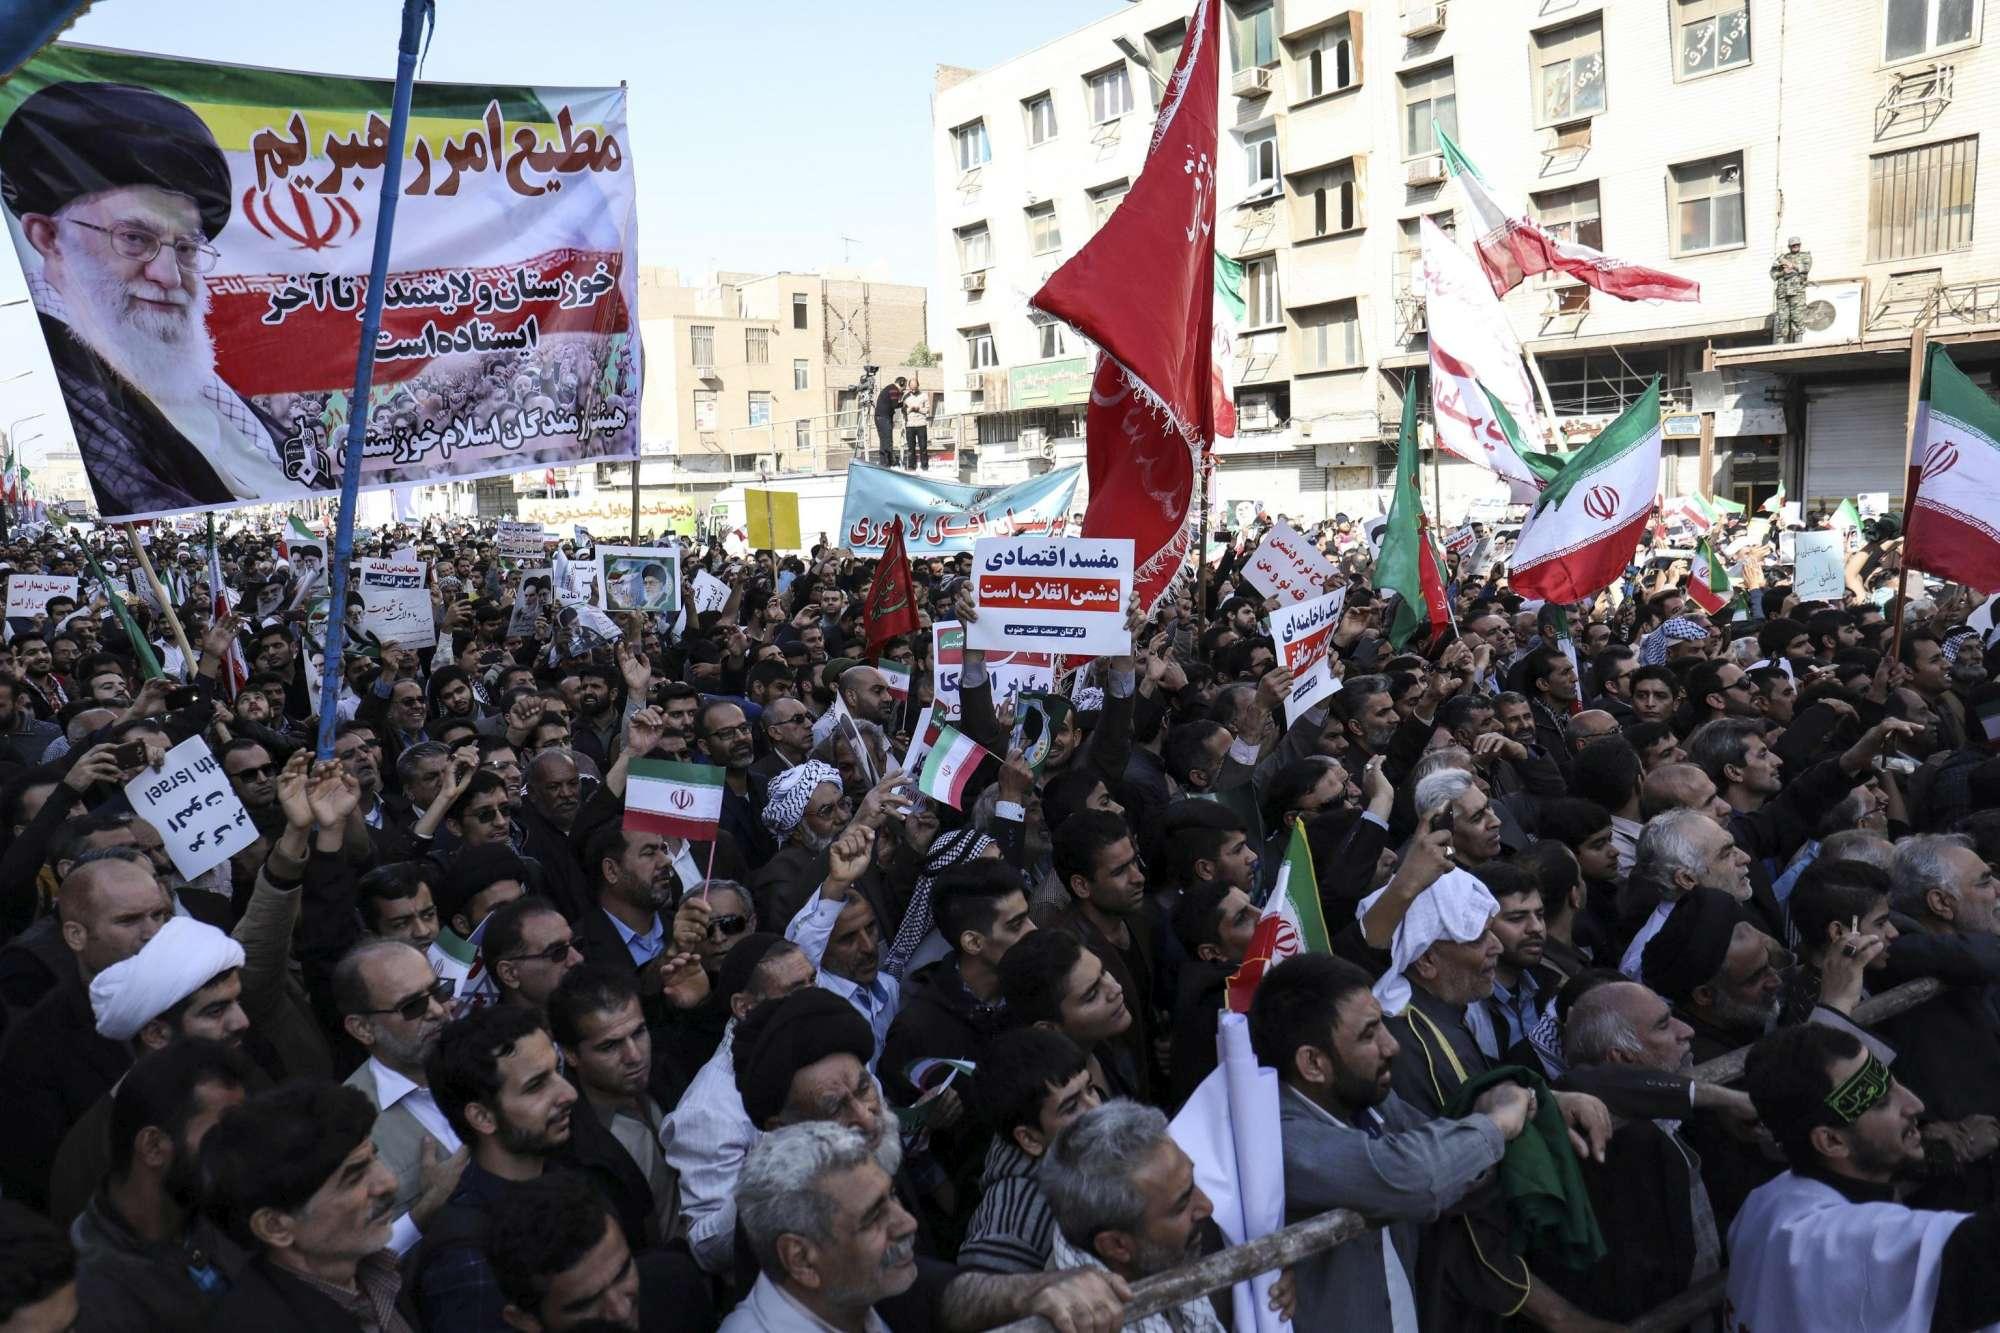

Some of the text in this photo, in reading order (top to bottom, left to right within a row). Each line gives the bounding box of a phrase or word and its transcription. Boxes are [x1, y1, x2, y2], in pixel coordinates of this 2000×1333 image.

[434, 99, 502, 197] امر
[505, 104, 622, 197] مطیع
[263, 271, 331, 323] آخر
[334, 275, 354, 308] تا
[356, 271, 496, 321] ولایتمد
[498, 263, 614, 309] خوزستان
[374, 315, 538, 359] ایستاده است
[441, 413, 501, 458] اسلام
[589, 401, 628, 437] هیئت
[338, 415, 441, 467] خوزستن
[849, 512, 925, 547] لاوری
[926, 511, 986, 545] اقبال
[985, 545, 1119, 572] مفسد اقتصادی
[1270, 536, 1297, 560] دشمن
[980, 581, 1119, 606] دشمن انقلاب است
[1006, 626, 1025, 635] جنوب
[1040, 626, 1059, 635] صنعت
[1060, 627, 1084, 637] کارکنان
[145, 767, 197, 806] Israel
